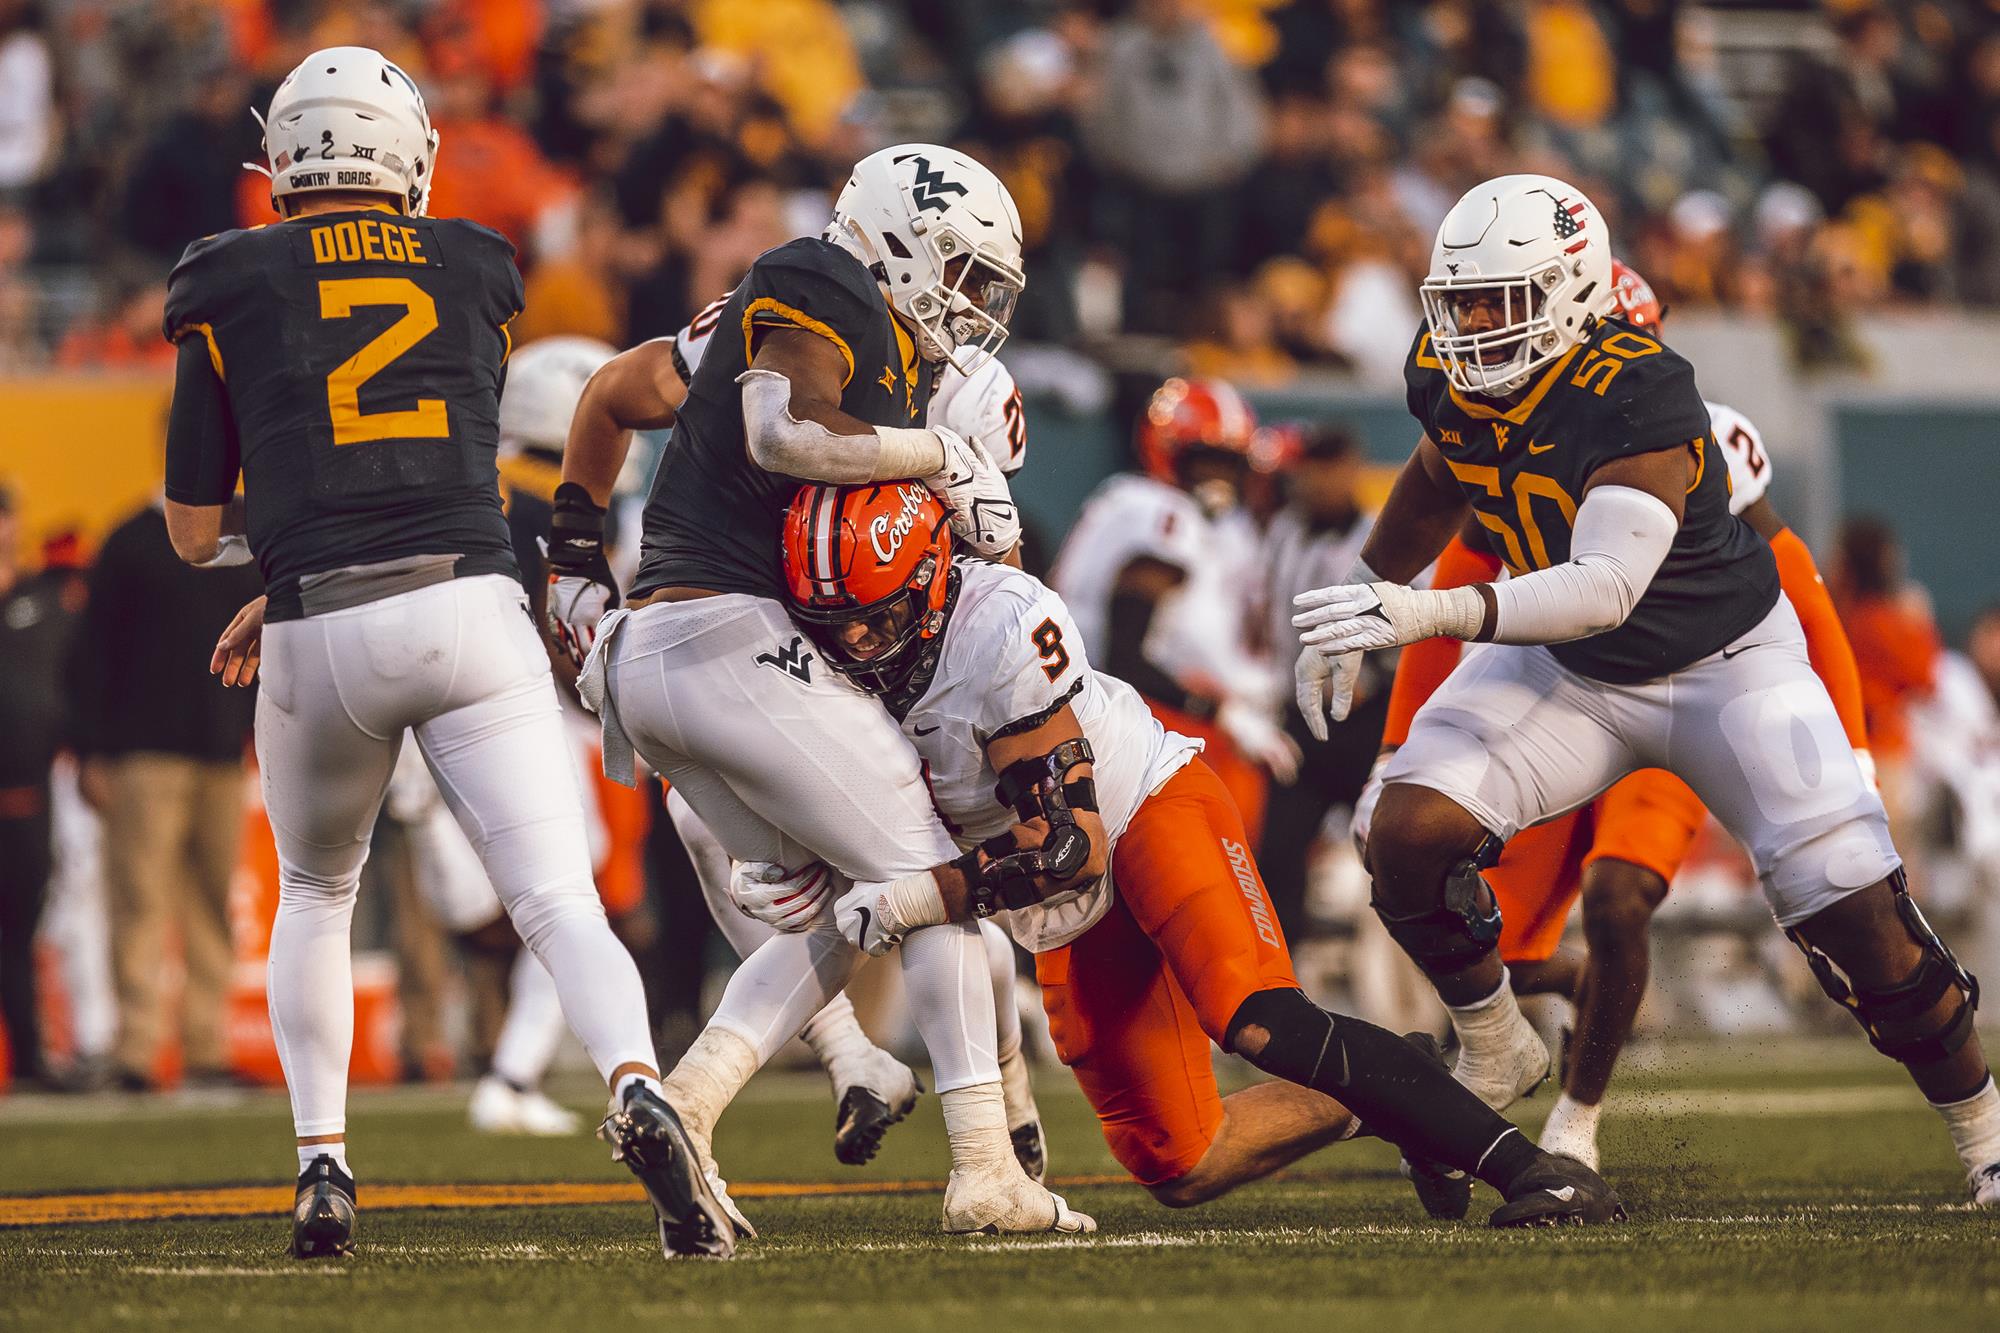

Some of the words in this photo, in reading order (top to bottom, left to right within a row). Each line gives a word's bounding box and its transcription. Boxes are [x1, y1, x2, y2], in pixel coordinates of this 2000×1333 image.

[338, 171, 371, 185] ROADS
[350, 143, 377, 161] XII
[310, 219, 427, 264] DOEGE
[317, 277, 450, 446] 2
[1570, 332, 1663, 396] 50
[1727, 422, 1765, 480] 2
[869, 480, 932, 565] Cowboy
[1443, 456, 1578, 577] 50
[1031, 617, 1071, 684] 9
[1220, 836, 1281, 949] COWBOYS
